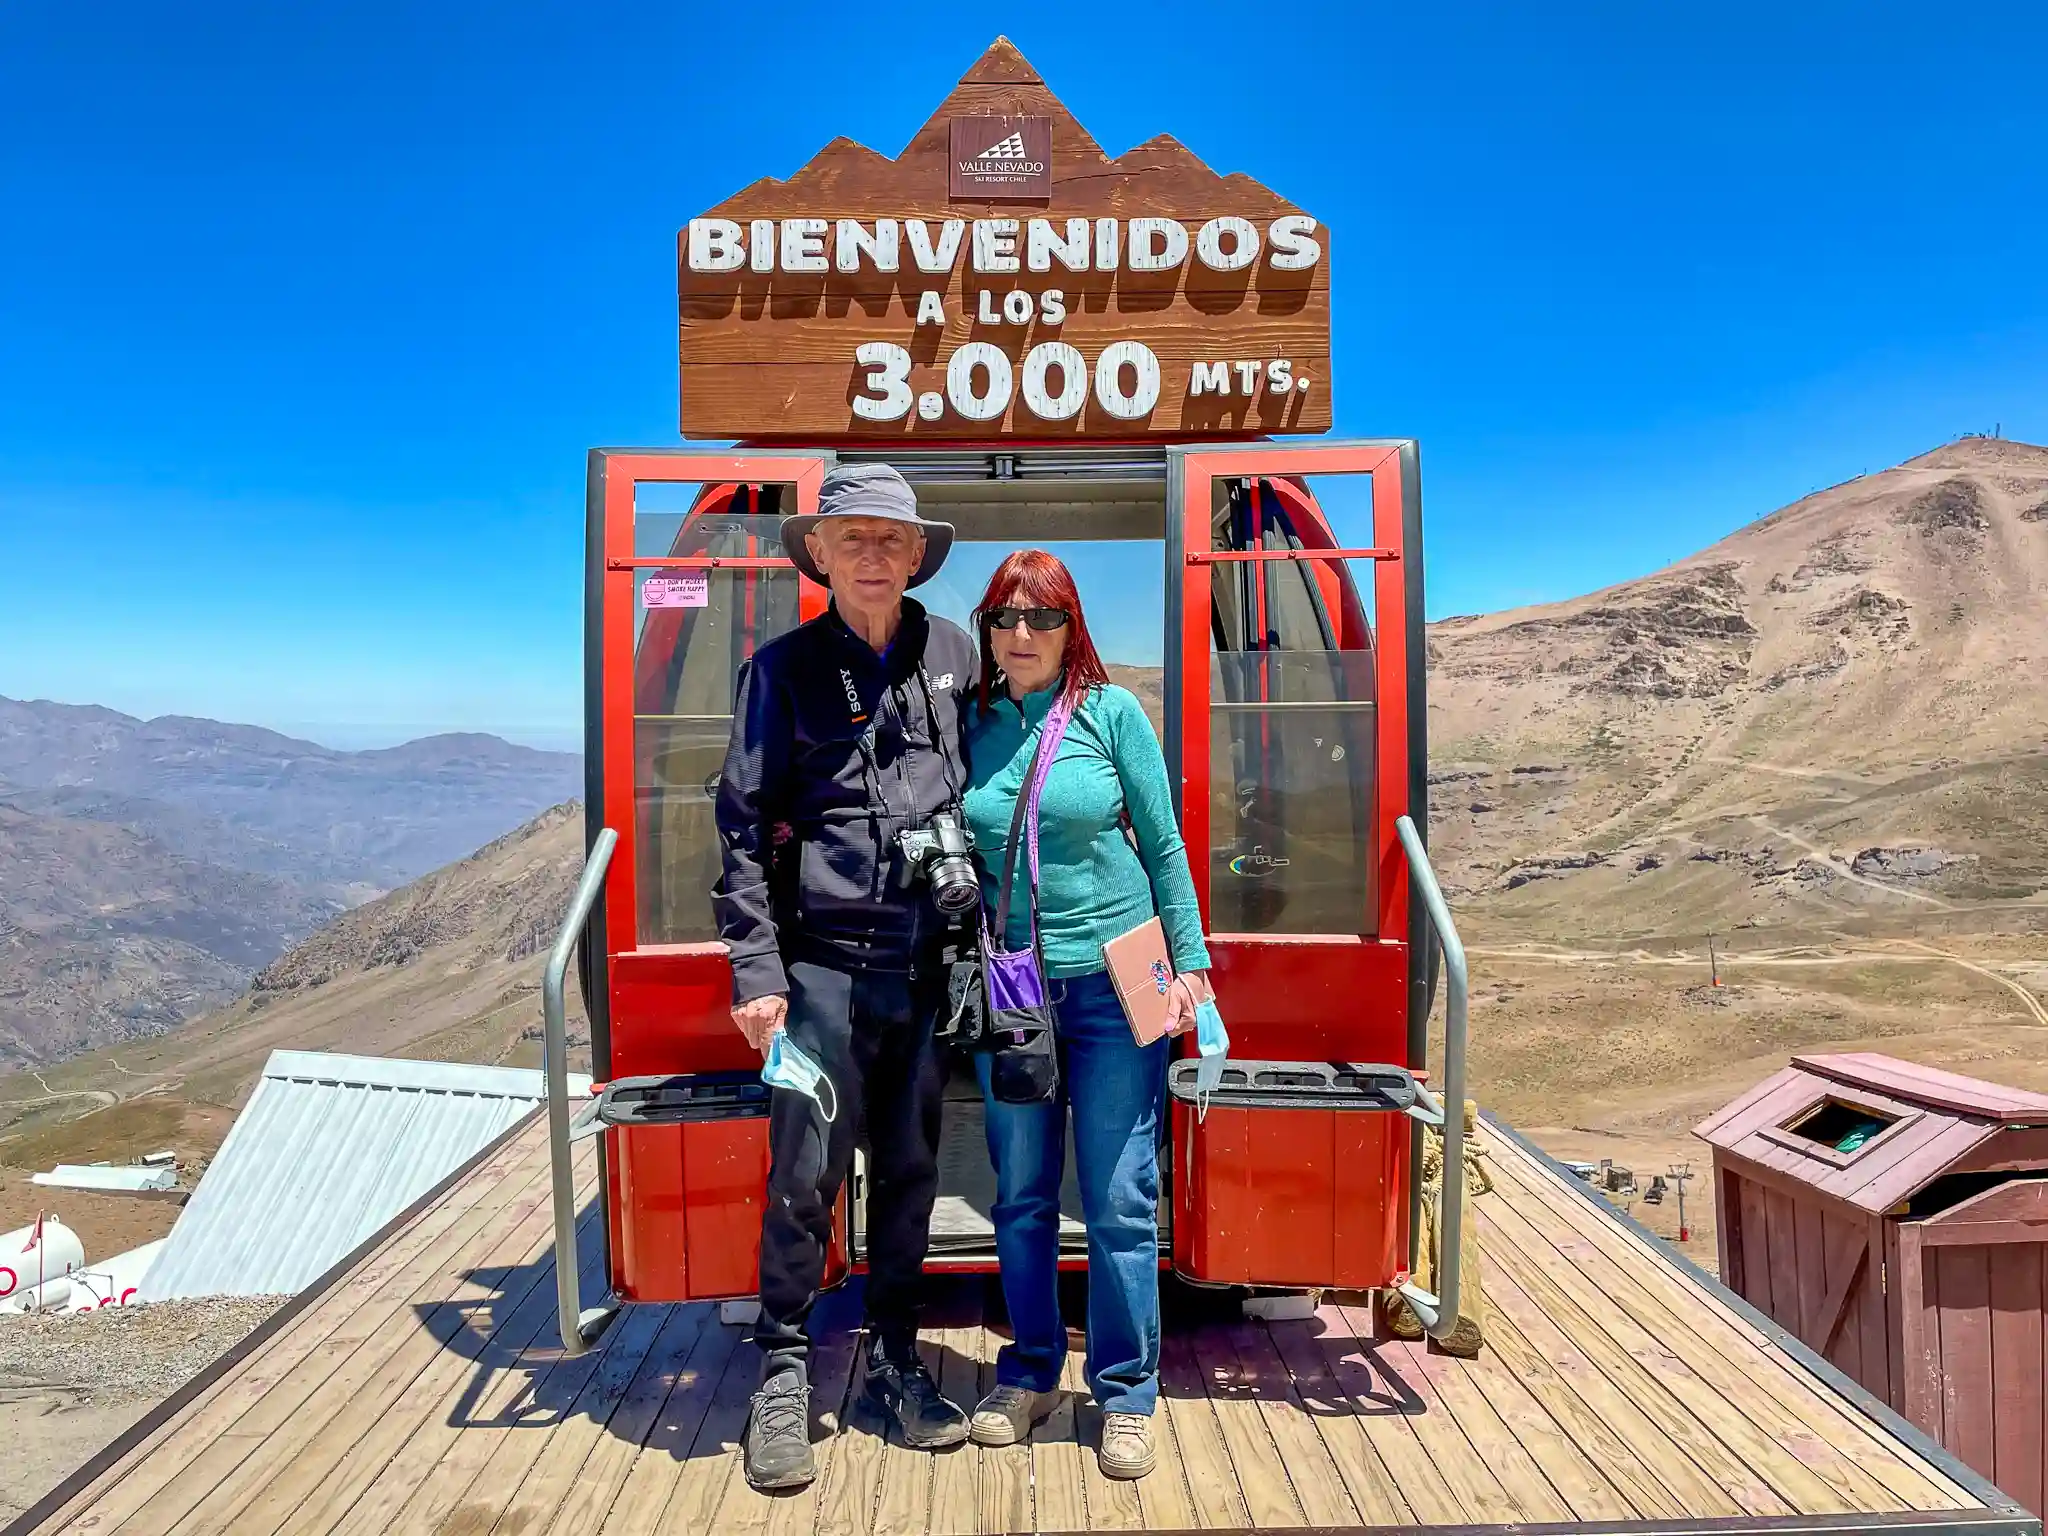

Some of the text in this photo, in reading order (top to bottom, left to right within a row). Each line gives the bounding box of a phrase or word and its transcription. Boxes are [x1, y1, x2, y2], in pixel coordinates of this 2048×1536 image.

[959, 161, 1044, 172] VALLE NEVADO
[688, 215, 1321, 274] BIENVENIDOS
[917, 289, 1067, 326] A LOS
[852, 341, 1310, 421] 3.000 MTS.
[840, 668, 862, 713] SONY
